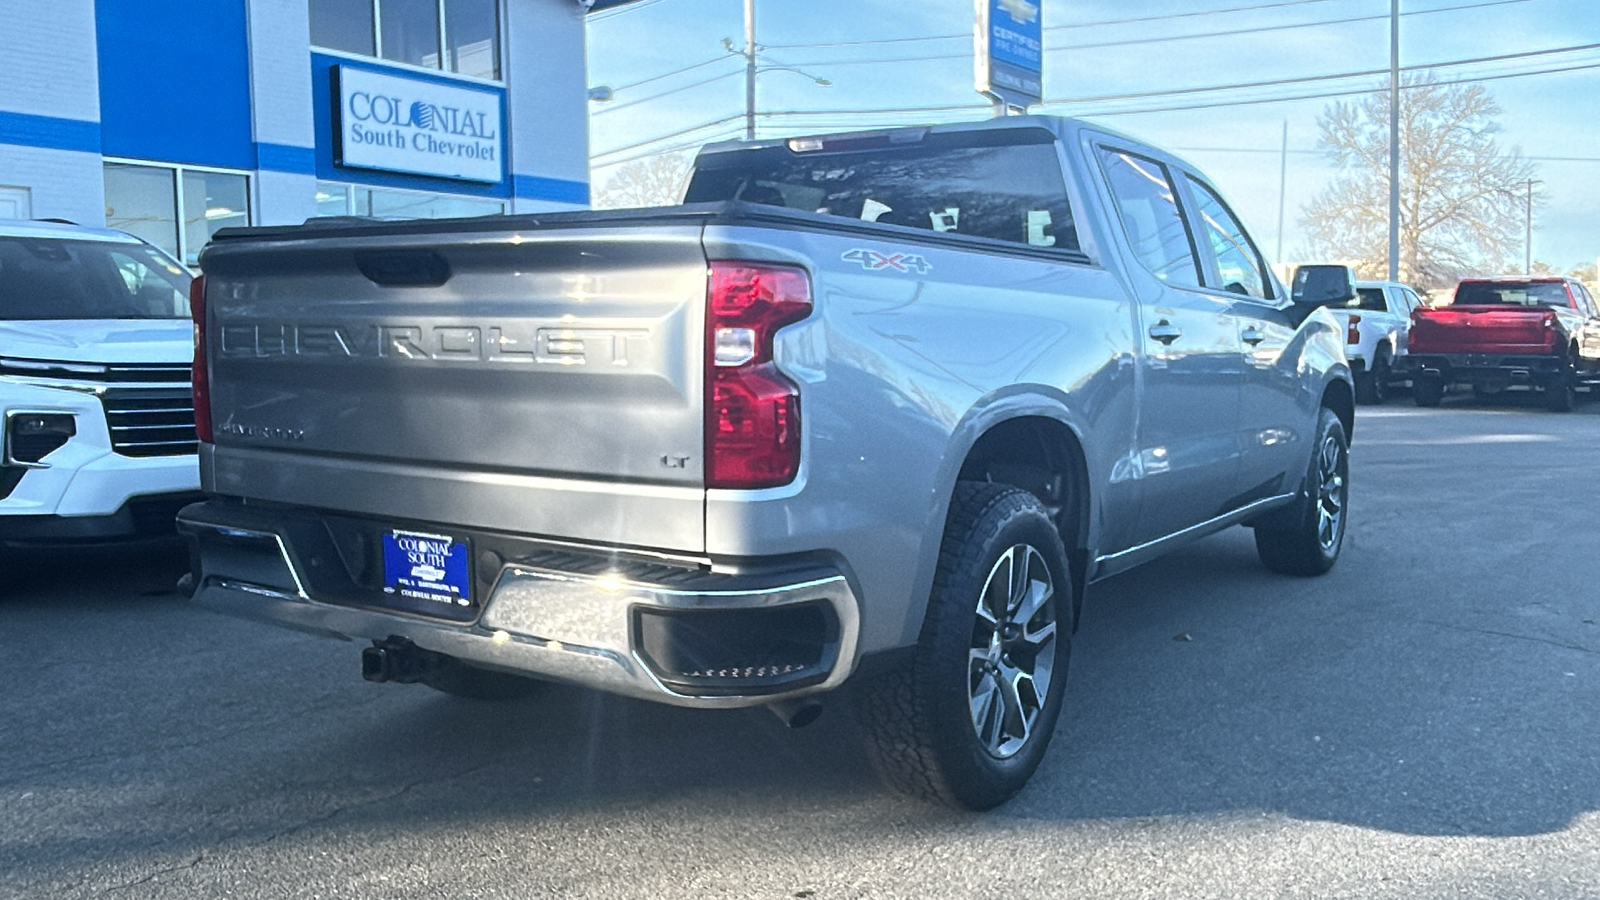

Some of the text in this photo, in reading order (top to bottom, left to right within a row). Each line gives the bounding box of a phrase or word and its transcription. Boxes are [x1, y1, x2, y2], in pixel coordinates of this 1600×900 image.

[350, 91, 496, 140] COLONIAL
[352, 124, 495, 161] South Chevrolet
[220, 323, 651, 366] CHEVROLET
[660, 455, 690, 468] LT
[398, 538, 452, 556] COLONIAL
[408, 551, 445, 568] SOUTH
